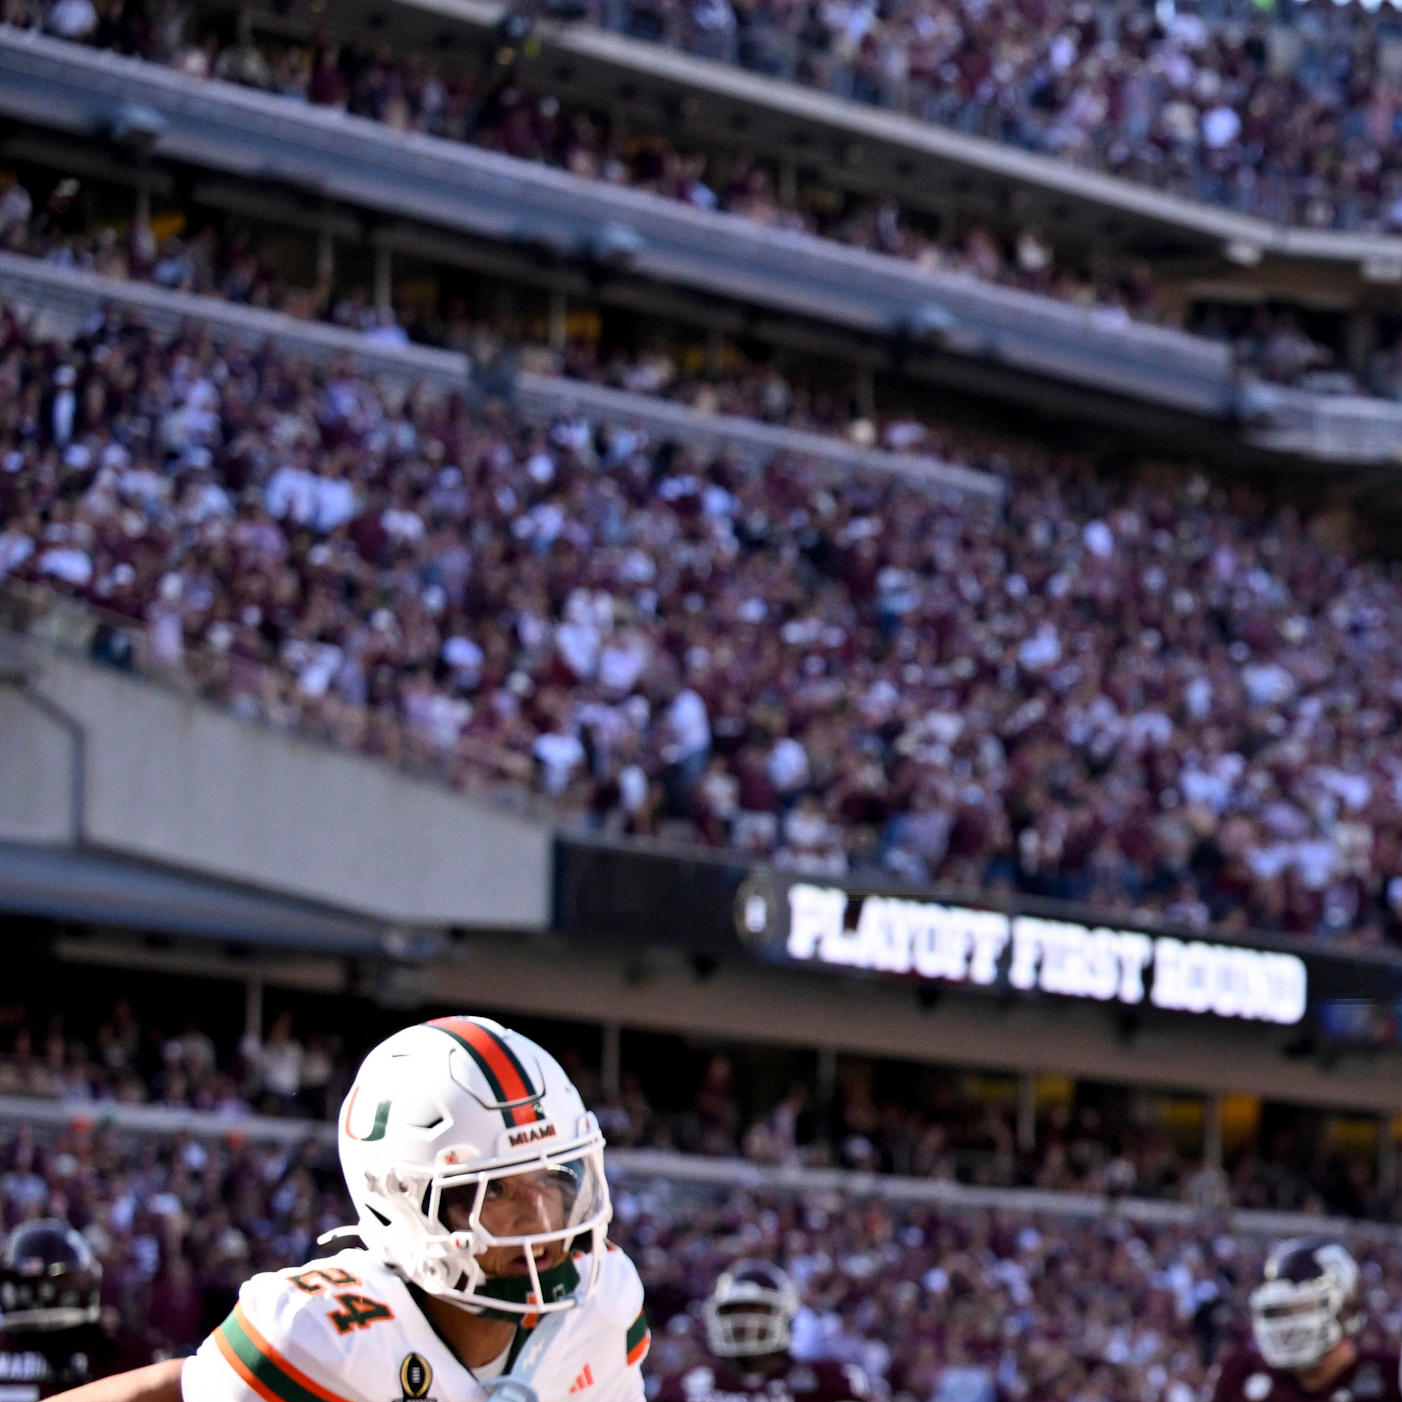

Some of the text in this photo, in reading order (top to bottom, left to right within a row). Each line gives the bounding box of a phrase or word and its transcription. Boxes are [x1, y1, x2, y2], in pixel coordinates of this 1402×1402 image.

[787, 882, 1011, 986] PLAYOFF
[1008, 914, 1152, 1005] FIRST
[508, 1124, 557, 1147] MIAMI
[286, 1267, 396, 1336] 24
